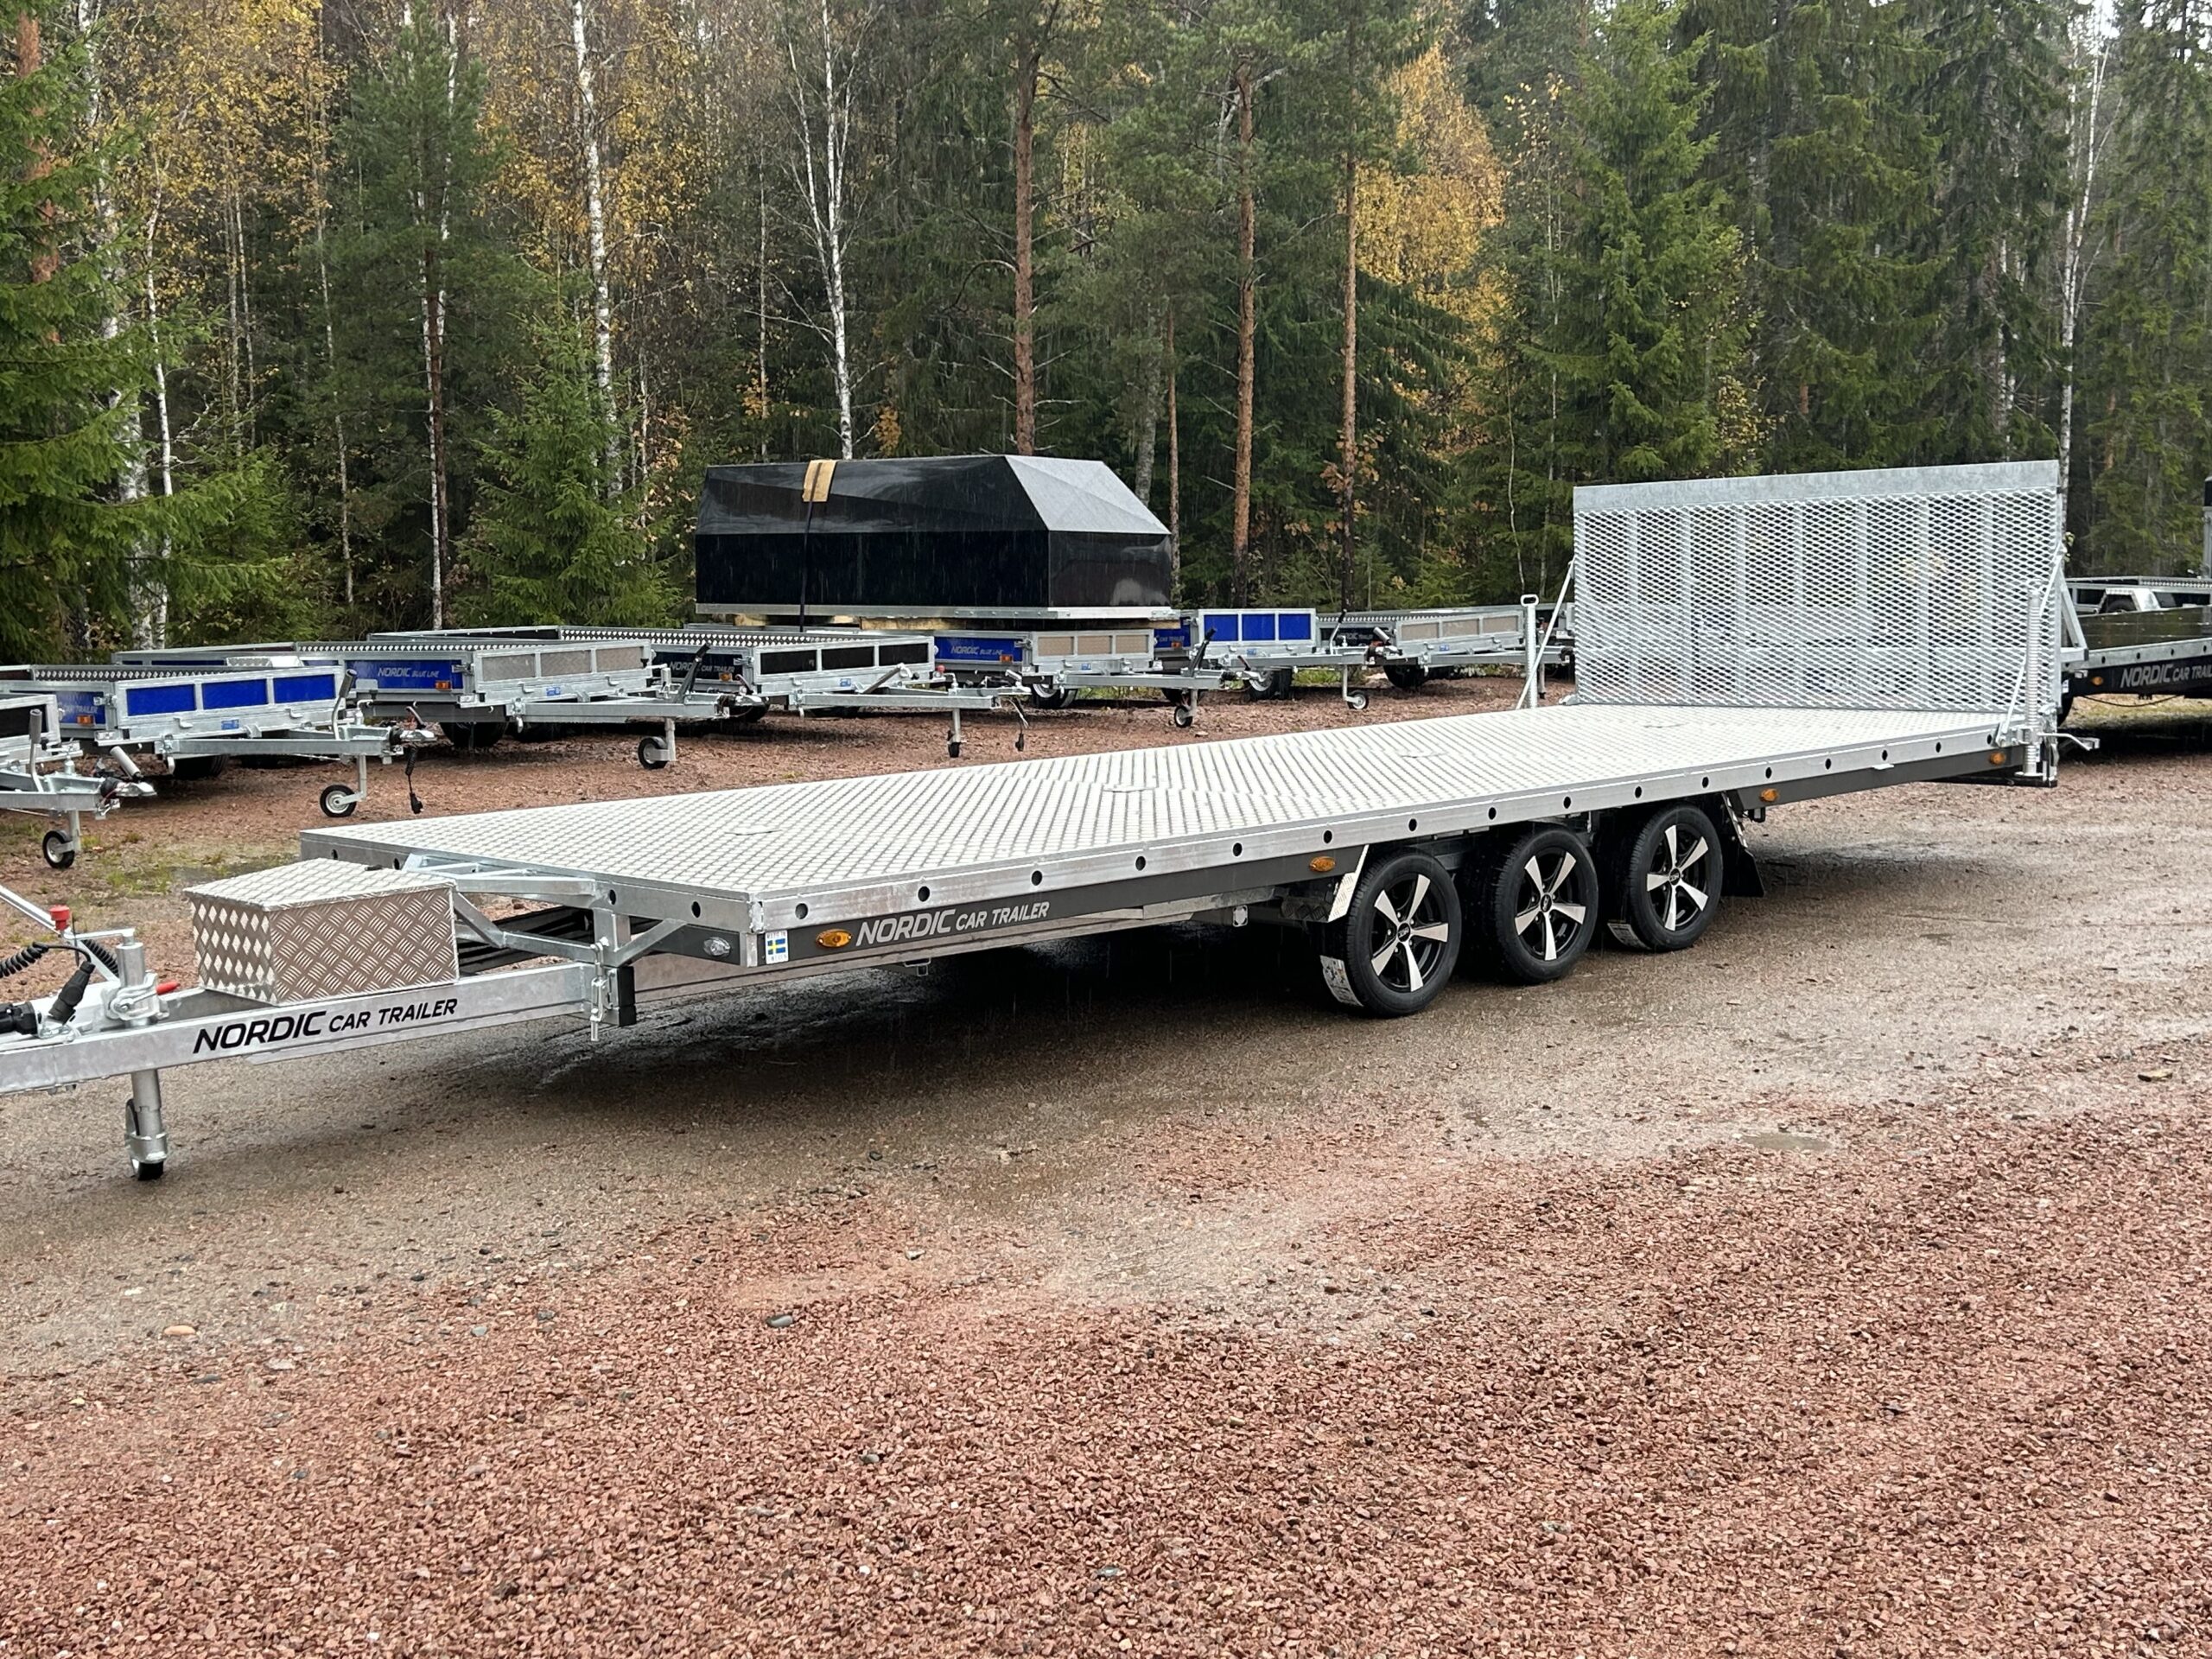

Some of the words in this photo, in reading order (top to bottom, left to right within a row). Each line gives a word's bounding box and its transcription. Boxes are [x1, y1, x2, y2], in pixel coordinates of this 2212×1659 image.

[951, 645, 980, 655] NORDIC
[378, 667, 412, 677] NORDIC
[2120, 664, 2174, 688] NORDIC
[2172, 667, 2190, 682] CAR
[850, 909, 956, 947] NORDIC
[956, 911, 988, 931] CAR
[992, 901, 1050, 925] TRAILER
[193, 1011, 327, 1054] NORDIC
[329, 1011, 371, 1033] CAR
[378, 998, 458, 1027] TRAILER
